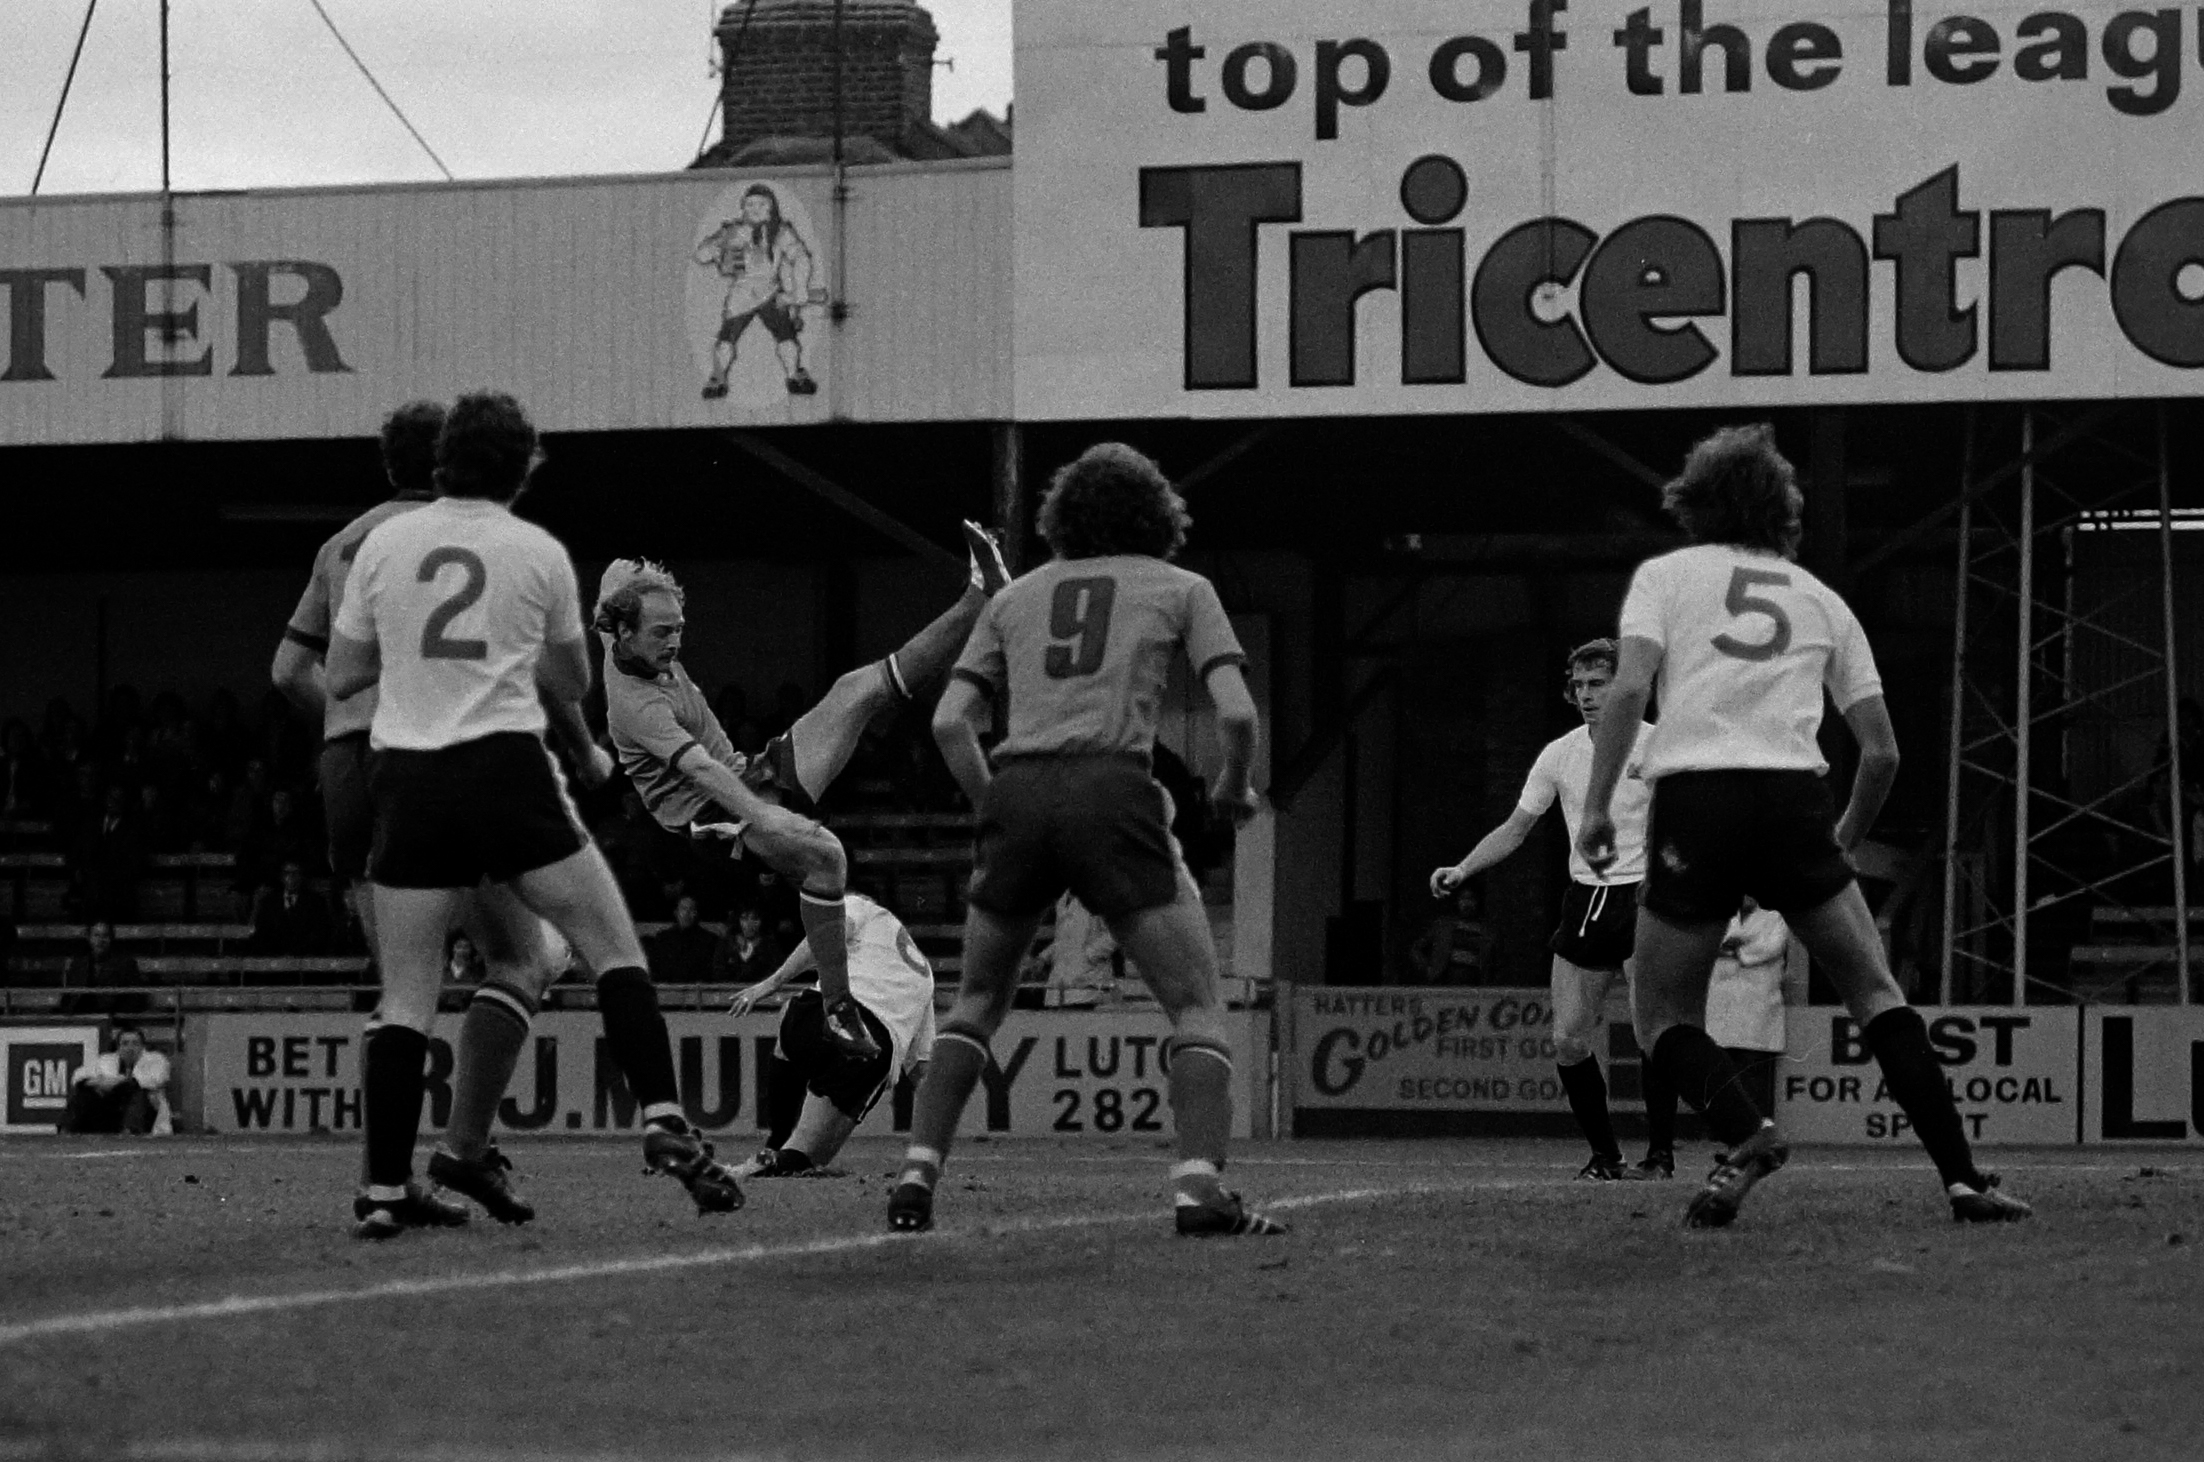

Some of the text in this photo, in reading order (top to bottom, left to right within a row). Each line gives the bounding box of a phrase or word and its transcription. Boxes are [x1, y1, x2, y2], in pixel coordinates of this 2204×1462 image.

[1154, 0, 2204, 140] top of the leag
[1139, 153, 2204, 390] Tricentro
[0, 260, 357, 381] TER
[416, 546, 488, 660] 2
[1710, 566, 1792, 661] 5
[1045, 576, 1116, 679] 9
[1488, 995, 1556, 1030] GO
[246, 1036, 349, 1078] BET
[1055, 1036, 1171, 1078] LUT
[1435, 1036, 1558, 1061] FIRST GO
[1831, 1016, 2031, 1066] BST
[23, 1058, 68, 1097] GM
[1399, 1078, 1570, 1101] SECOND GO
[1786, 1076, 1862, 1102] FOR
[1946, 1077, 2062, 1103] LOCAL
[2102, 1016, 2204, 1139] L
[232, 1087, 363, 1129] WITH
[1866, 1113, 1989, 1139] SPT
